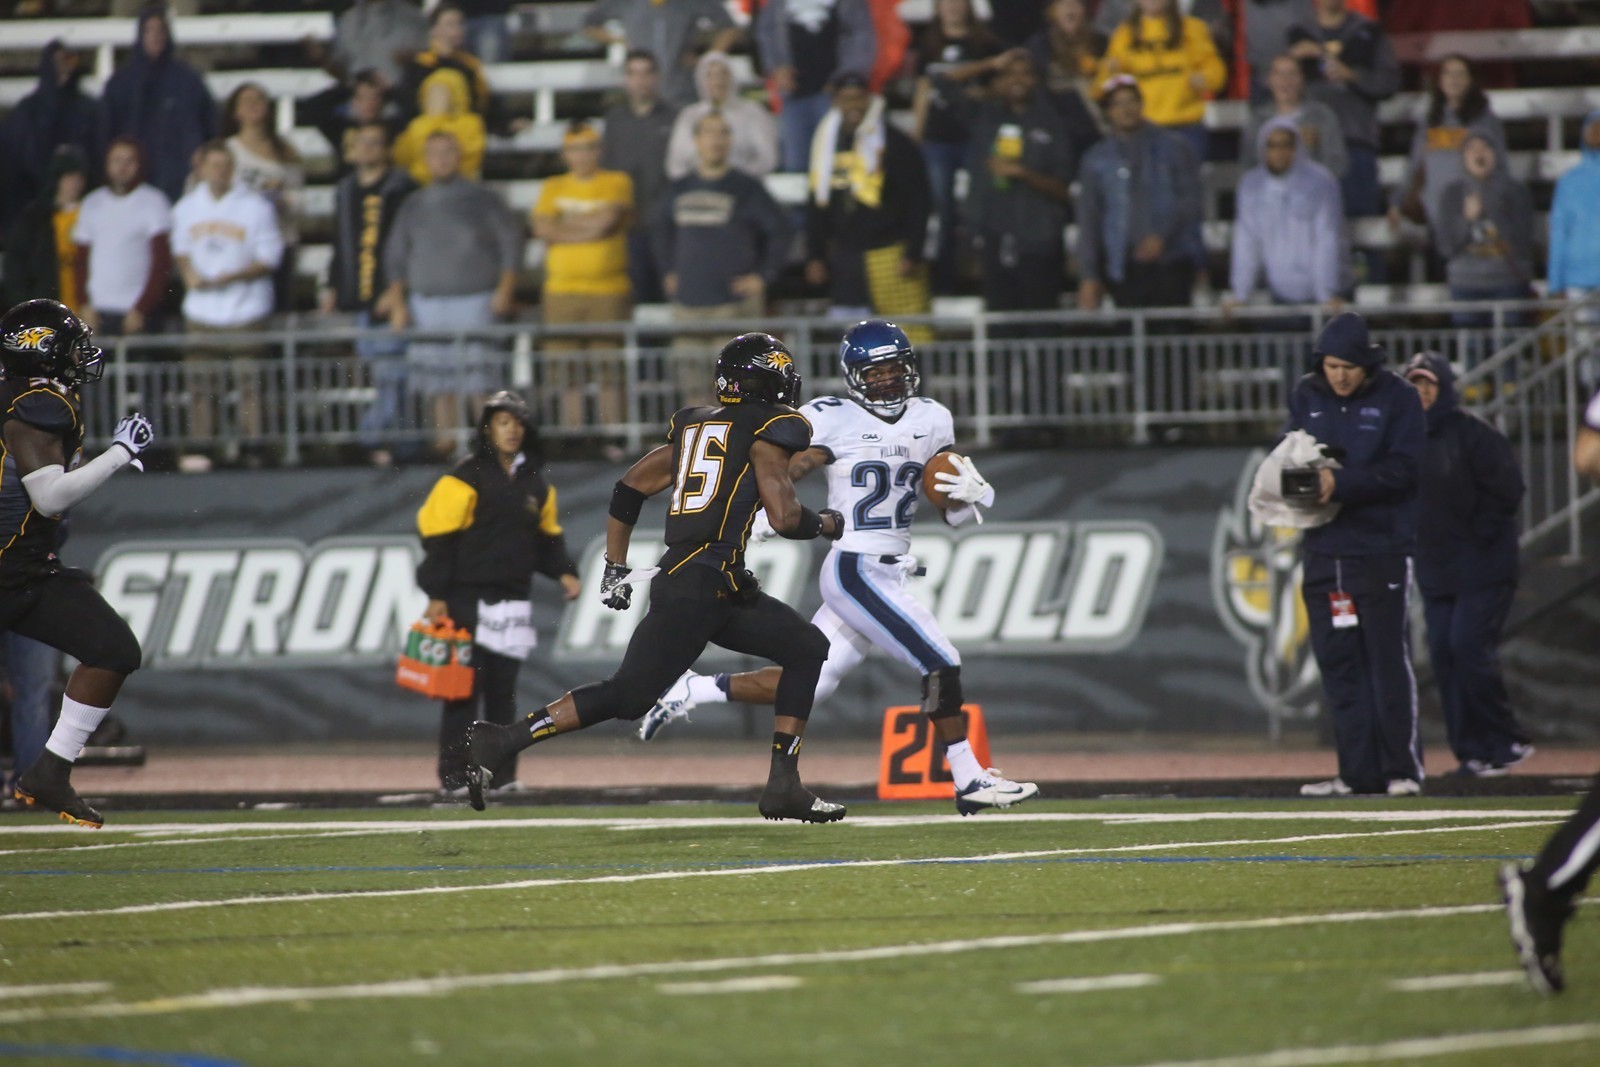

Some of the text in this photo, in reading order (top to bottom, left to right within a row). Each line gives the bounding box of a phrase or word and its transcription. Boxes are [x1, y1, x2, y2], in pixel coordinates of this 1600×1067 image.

[670, 421, 733, 516] 15
[851, 460, 924, 531] 22
[101, 551, 430, 652] STRON
[905, 534, 1152, 637] BOLD
